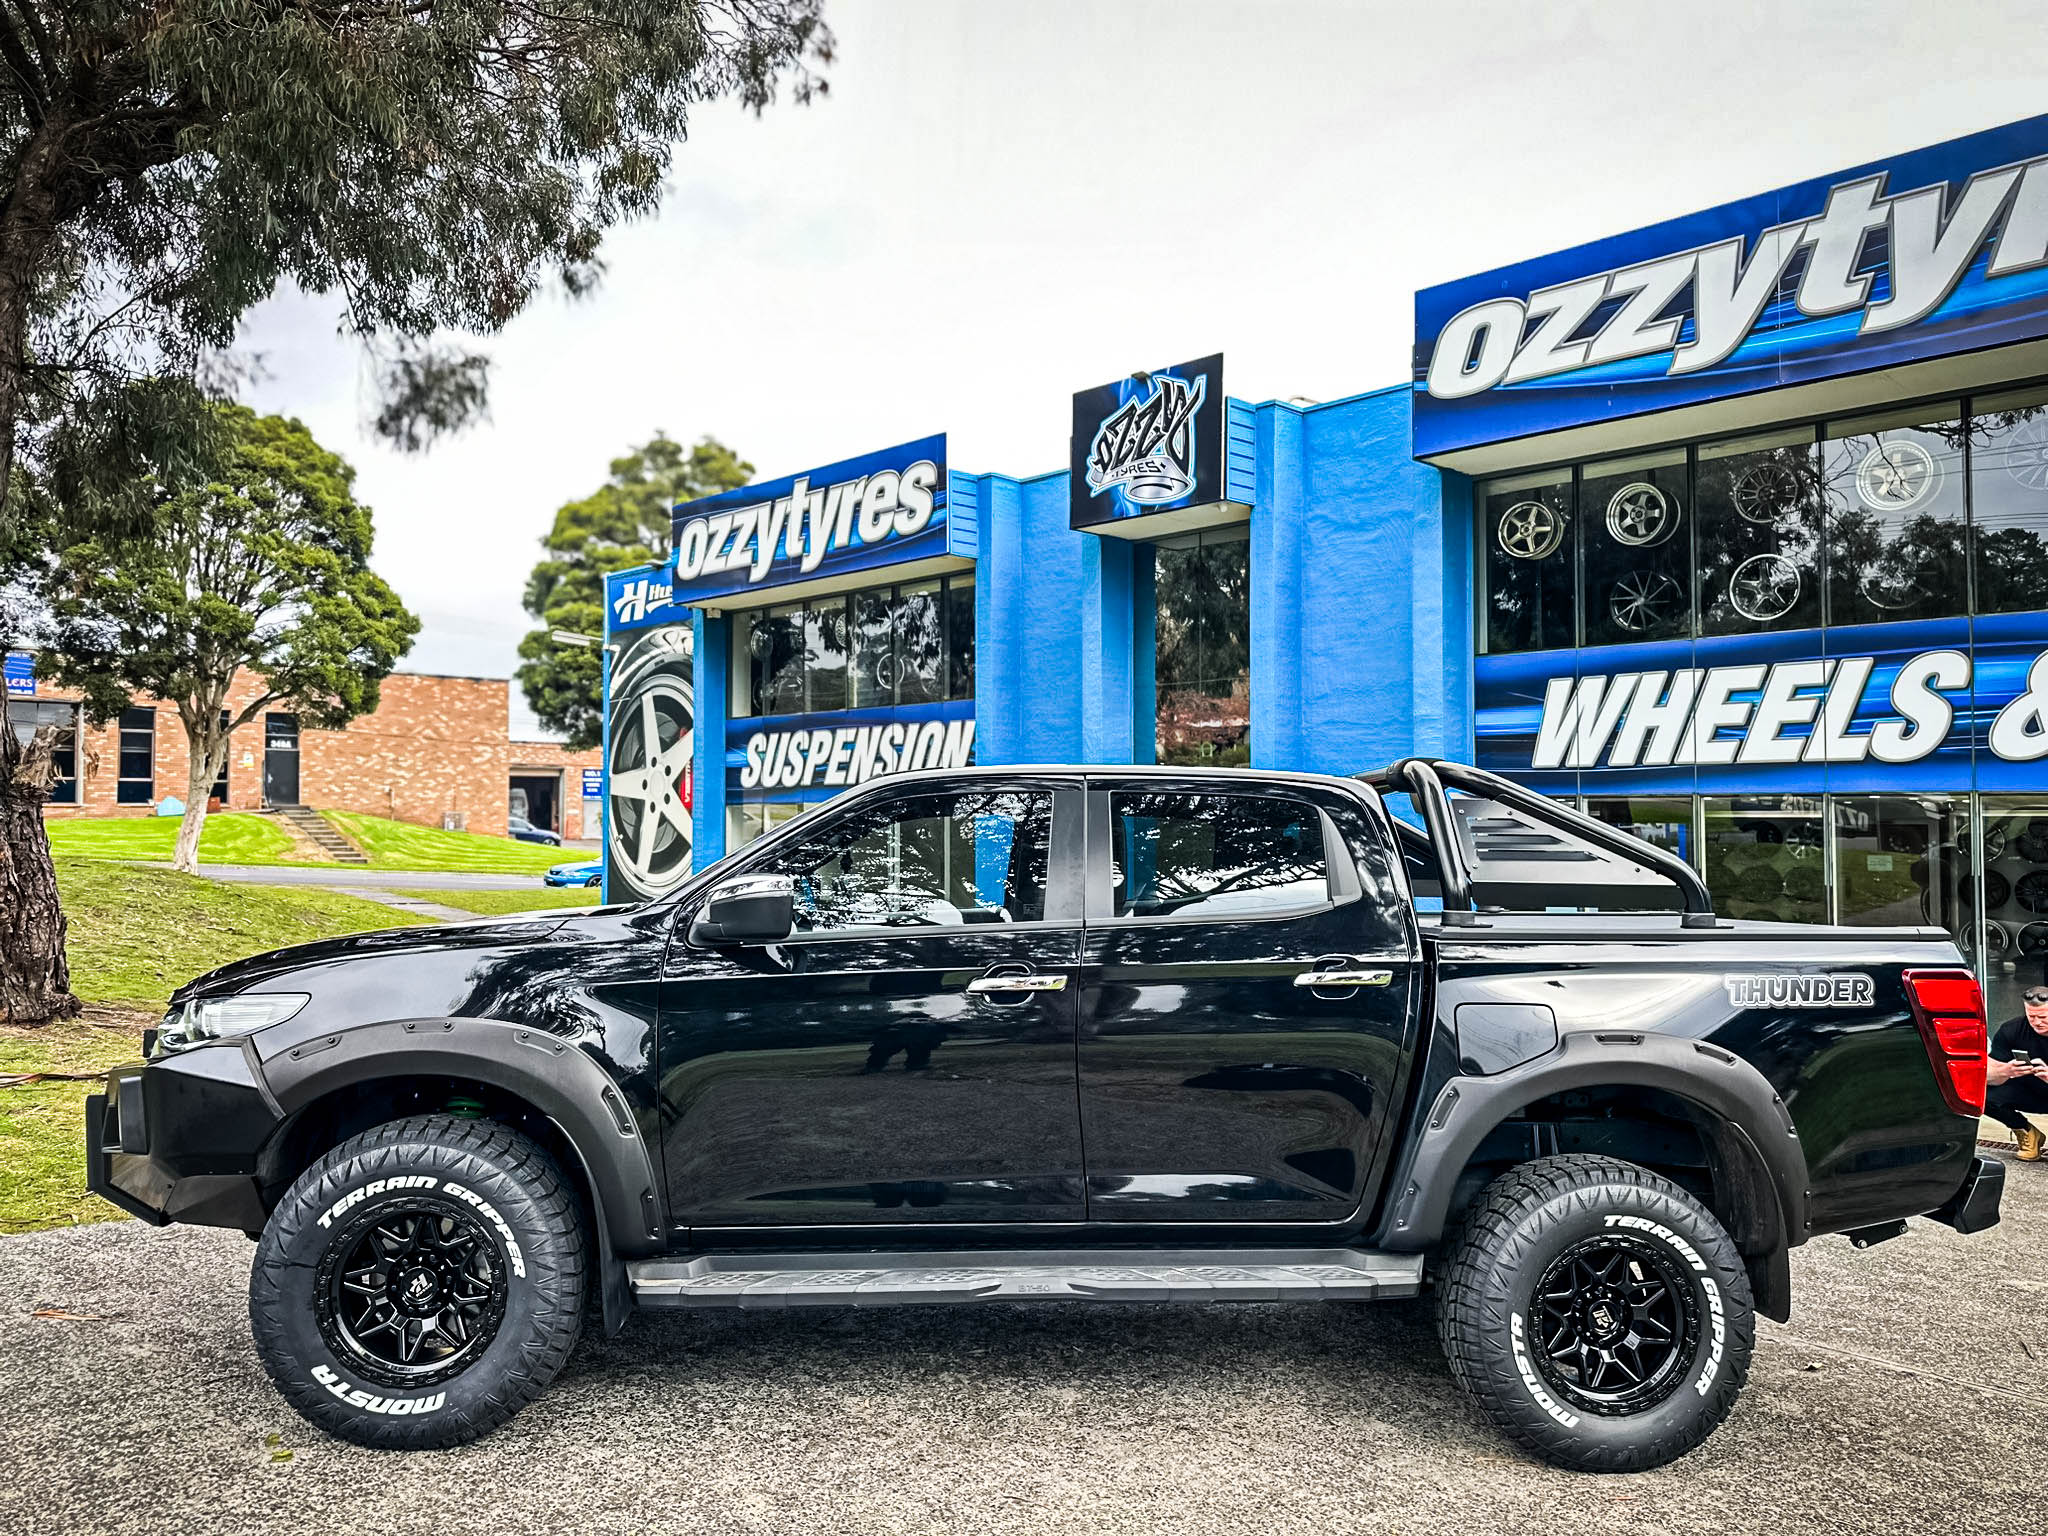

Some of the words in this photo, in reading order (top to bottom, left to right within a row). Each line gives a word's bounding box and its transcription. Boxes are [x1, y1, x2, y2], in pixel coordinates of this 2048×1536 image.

[1114, 460, 1162, 478] TYRES
[676, 459, 938, 584] ozzytyres
[740, 720, 976, 789] SUSPENSION
[1532, 649, 1972, 768] WHEELS
[1725, 973, 1875, 1008] THUNDER
[316, 1175, 438, 1230] TERRAIN
[442, 1181, 527, 1279] GRIPPER
[1602, 1214, 1707, 1271] TERRAIN
[1695, 1277, 1726, 1397] GRIPPER
[310, 1364, 447, 1416] MONSTA
[1510, 1312, 1580, 1428] MONSTA
